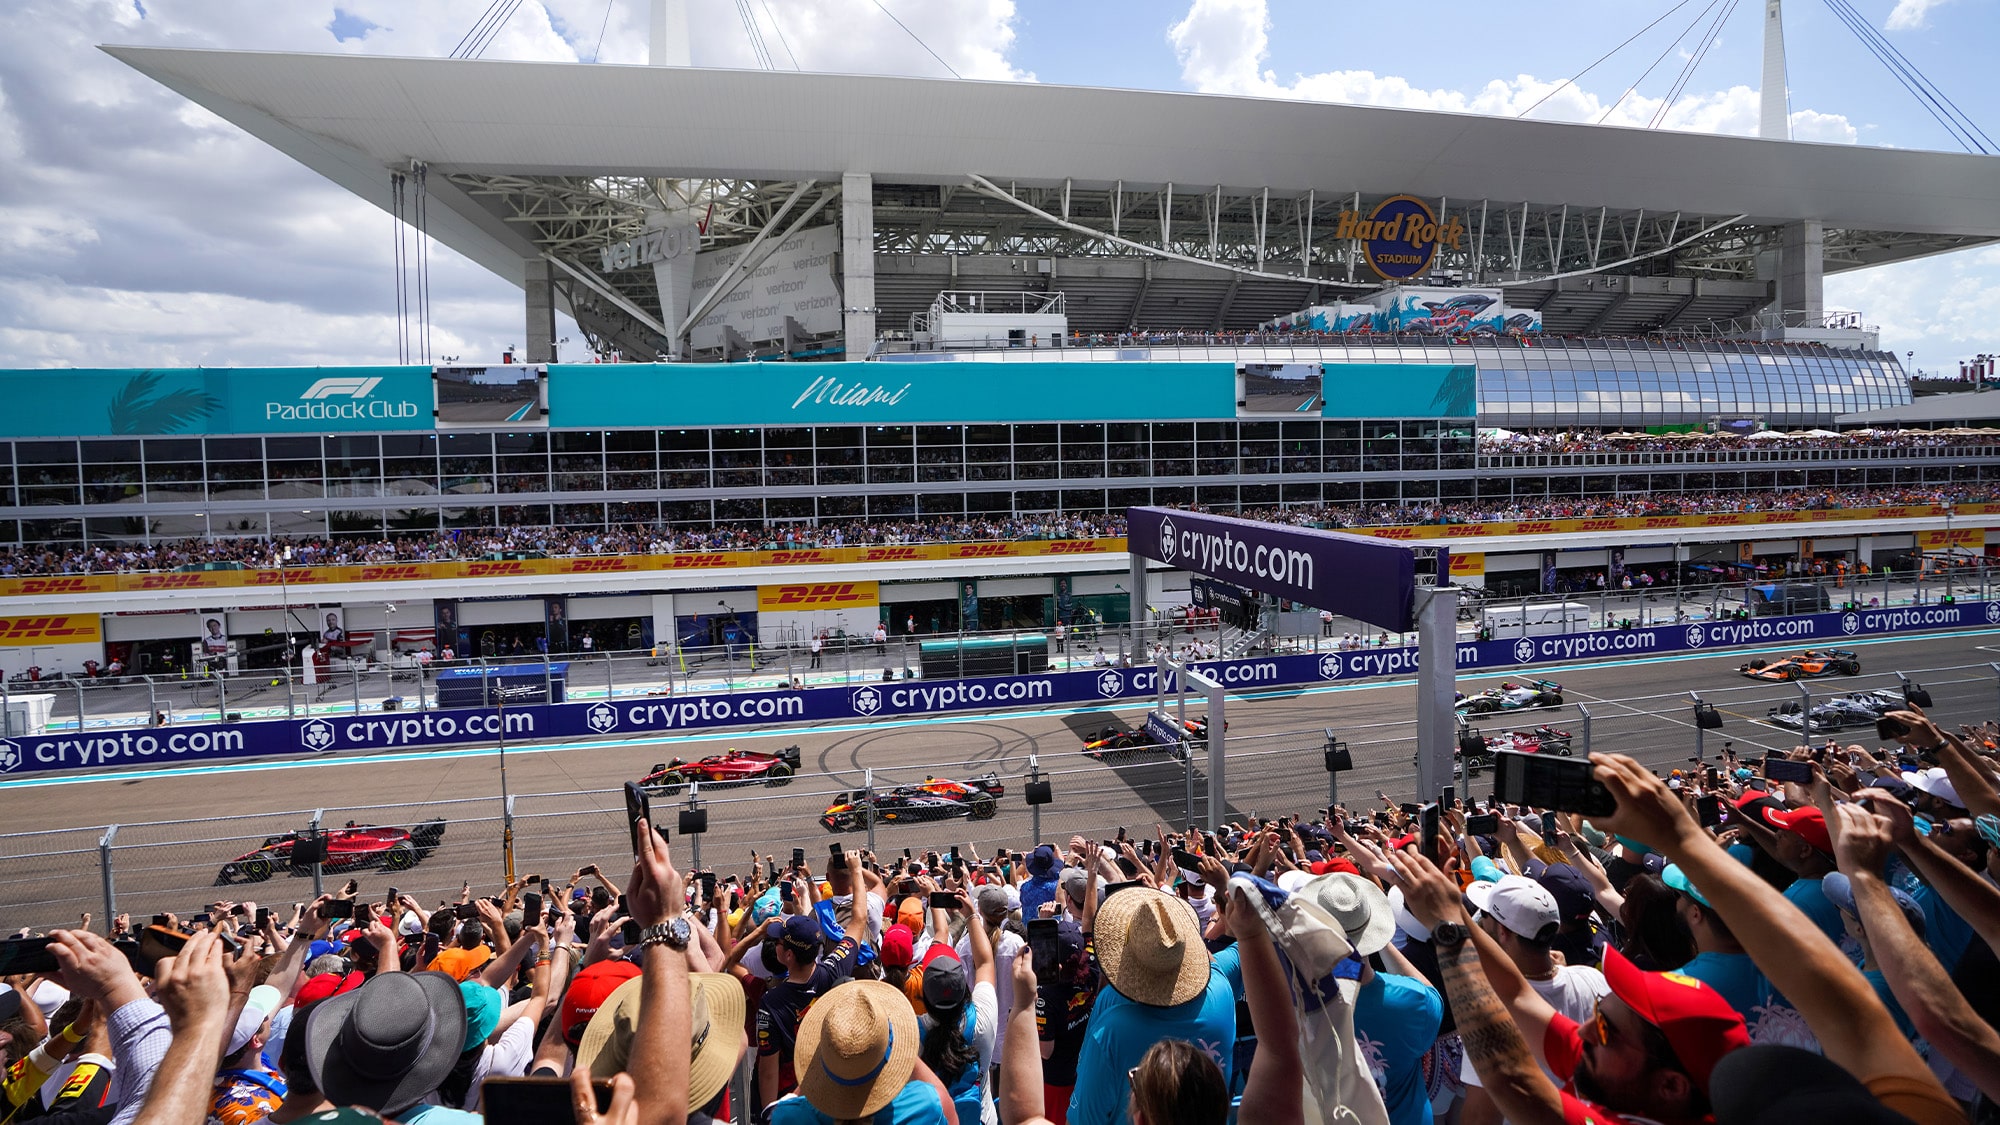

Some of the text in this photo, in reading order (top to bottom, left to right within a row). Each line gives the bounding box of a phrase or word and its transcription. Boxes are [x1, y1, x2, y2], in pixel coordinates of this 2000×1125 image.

[1336, 210, 1464, 250] Hard Rock
[600, 224, 700, 274] verizon
[1376, 254, 1422, 265] STADIUM
[766, 279, 804, 296] verizon
[794, 295, 834, 312] verizon
[741, 303, 777, 321] verizon
[300, 377, 383, 399] F1
[791, 375, 911, 409] Miami
[266, 401, 418, 420] Paddock Club
[1766, 512, 1797, 522] DHL
[1877, 508, 1907, 517] DHL
[1582, 520, 1618, 531] DHL
[1646, 518, 1680, 528] DHL
[1707, 515, 1740, 525] DHL
[1374, 528, 1413, 539] DHL
[1447, 526, 1486, 536] DHL
[1516, 523, 1553, 533] DHL
[1930, 530, 1973, 545] DHL
[959, 544, 1010, 557] DHL
[1050, 541, 1098, 553] DHL
[672, 555, 728, 568] DHL
[771, 551, 825, 564] DHL
[867, 548, 918, 561] DHL
[1181, 530, 1313, 591] crypto.com
[467, 562, 524, 576] DHL
[571, 559, 628, 572] DHL
[255, 570, 317, 584] DHL
[362, 566, 421, 580] DHL
[22, 578, 88, 593] DHL
[142, 574, 204, 588] DHL
[778, 584, 861, 604] DHL
[1866, 606, 1960, 631] crypto.com
[1711, 617, 1813, 645] crypto.com
[1541, 631, 1656, 658] crypto.com
[891, 678, 1052, 710] crypto.com
[628, 690, 803, 725] crypto.com
[346, 711, 534, 746] crypto.com
[34, 729, 244, 765] crypto.com
